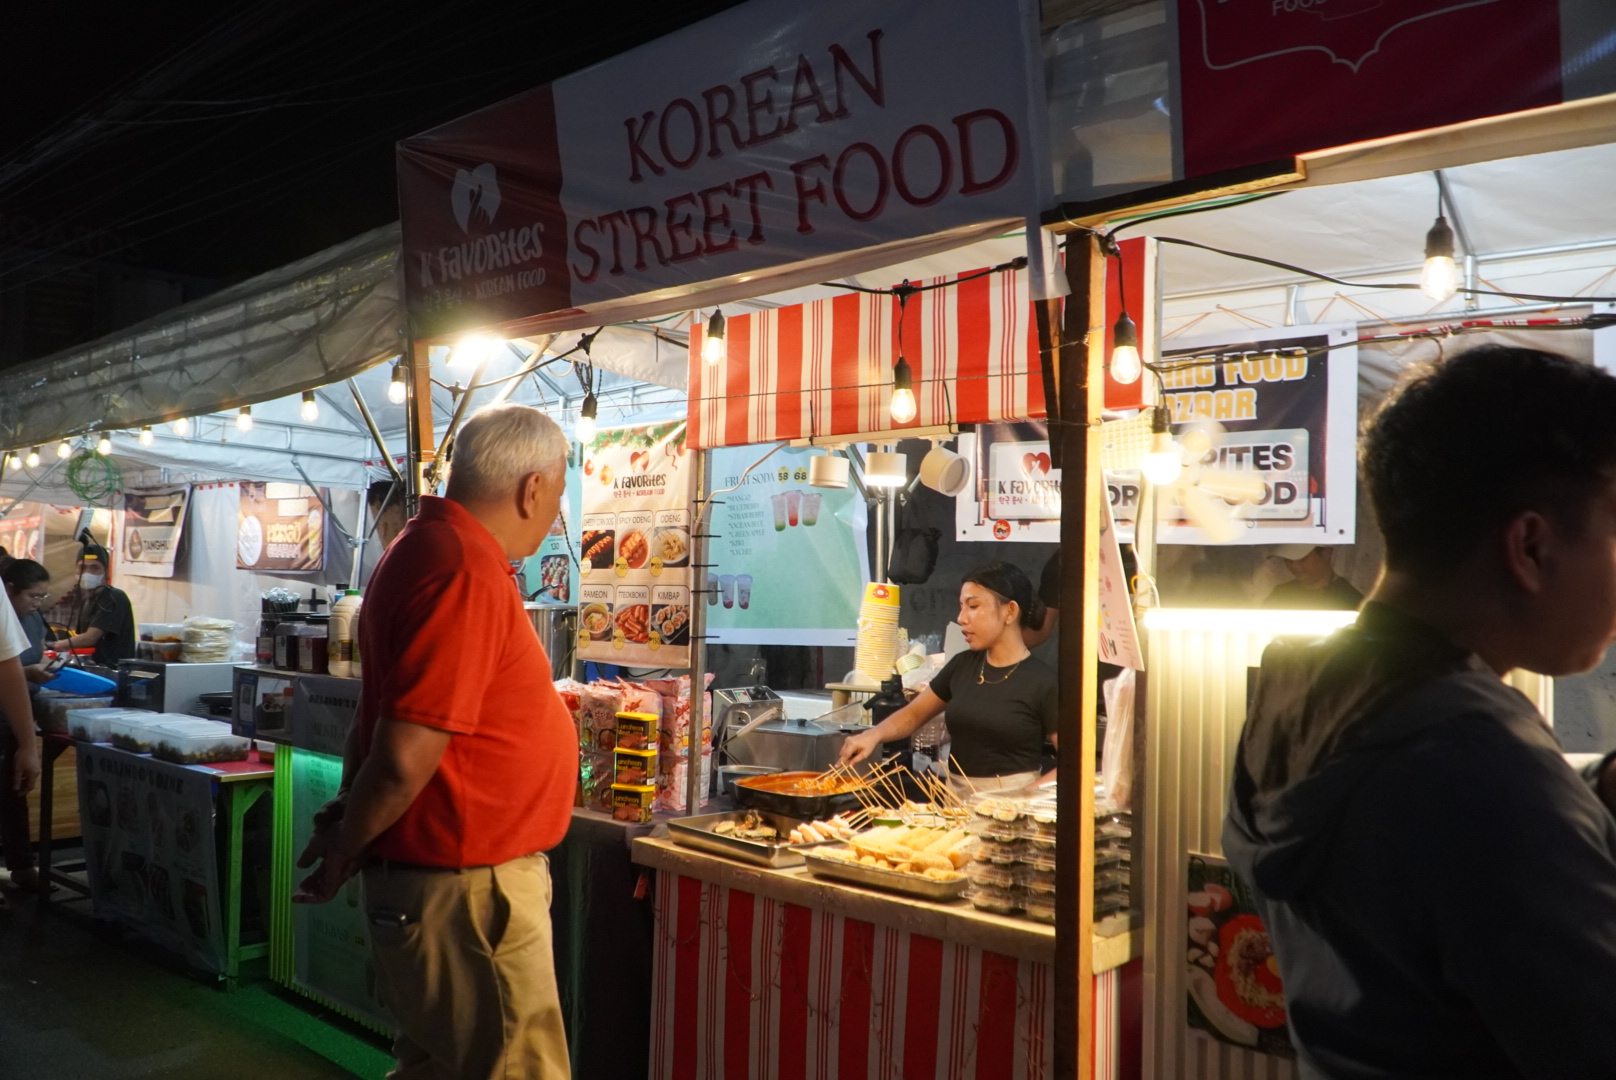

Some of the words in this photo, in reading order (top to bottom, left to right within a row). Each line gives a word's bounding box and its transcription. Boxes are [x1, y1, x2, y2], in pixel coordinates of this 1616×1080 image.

[623, 28, 886, 184] KOREAN
[570, 170, 774, 284] STREET
[790, 108, 1019, 235] FOOD
[420, 252, 434, 288] K
[475, 274, 515, 300] KOREAN
[517, 267, 546, 290] FOOD
[1224, 347, 1307, 385] FOOD
[1160, 388, 1257, 423] AZAAR
[752, 472, 776, 485] SODA
[778, 472, 789, 481] 58
[794, 472, 807, 480] 68
[998, 481, 1006, 494] K
[619, 517, 631, 525] SPICY
[632, 516, 652, 524] ODENG
[661, 515, 682, 523] ODENG
[729, 511, 764, 520] STRAWBERRY
[583, 591, 608, 599] RAMEON
[618, 591, 647, 599] TTEOKBOKKI
[657, 591, 680, 600] KIMBAP
